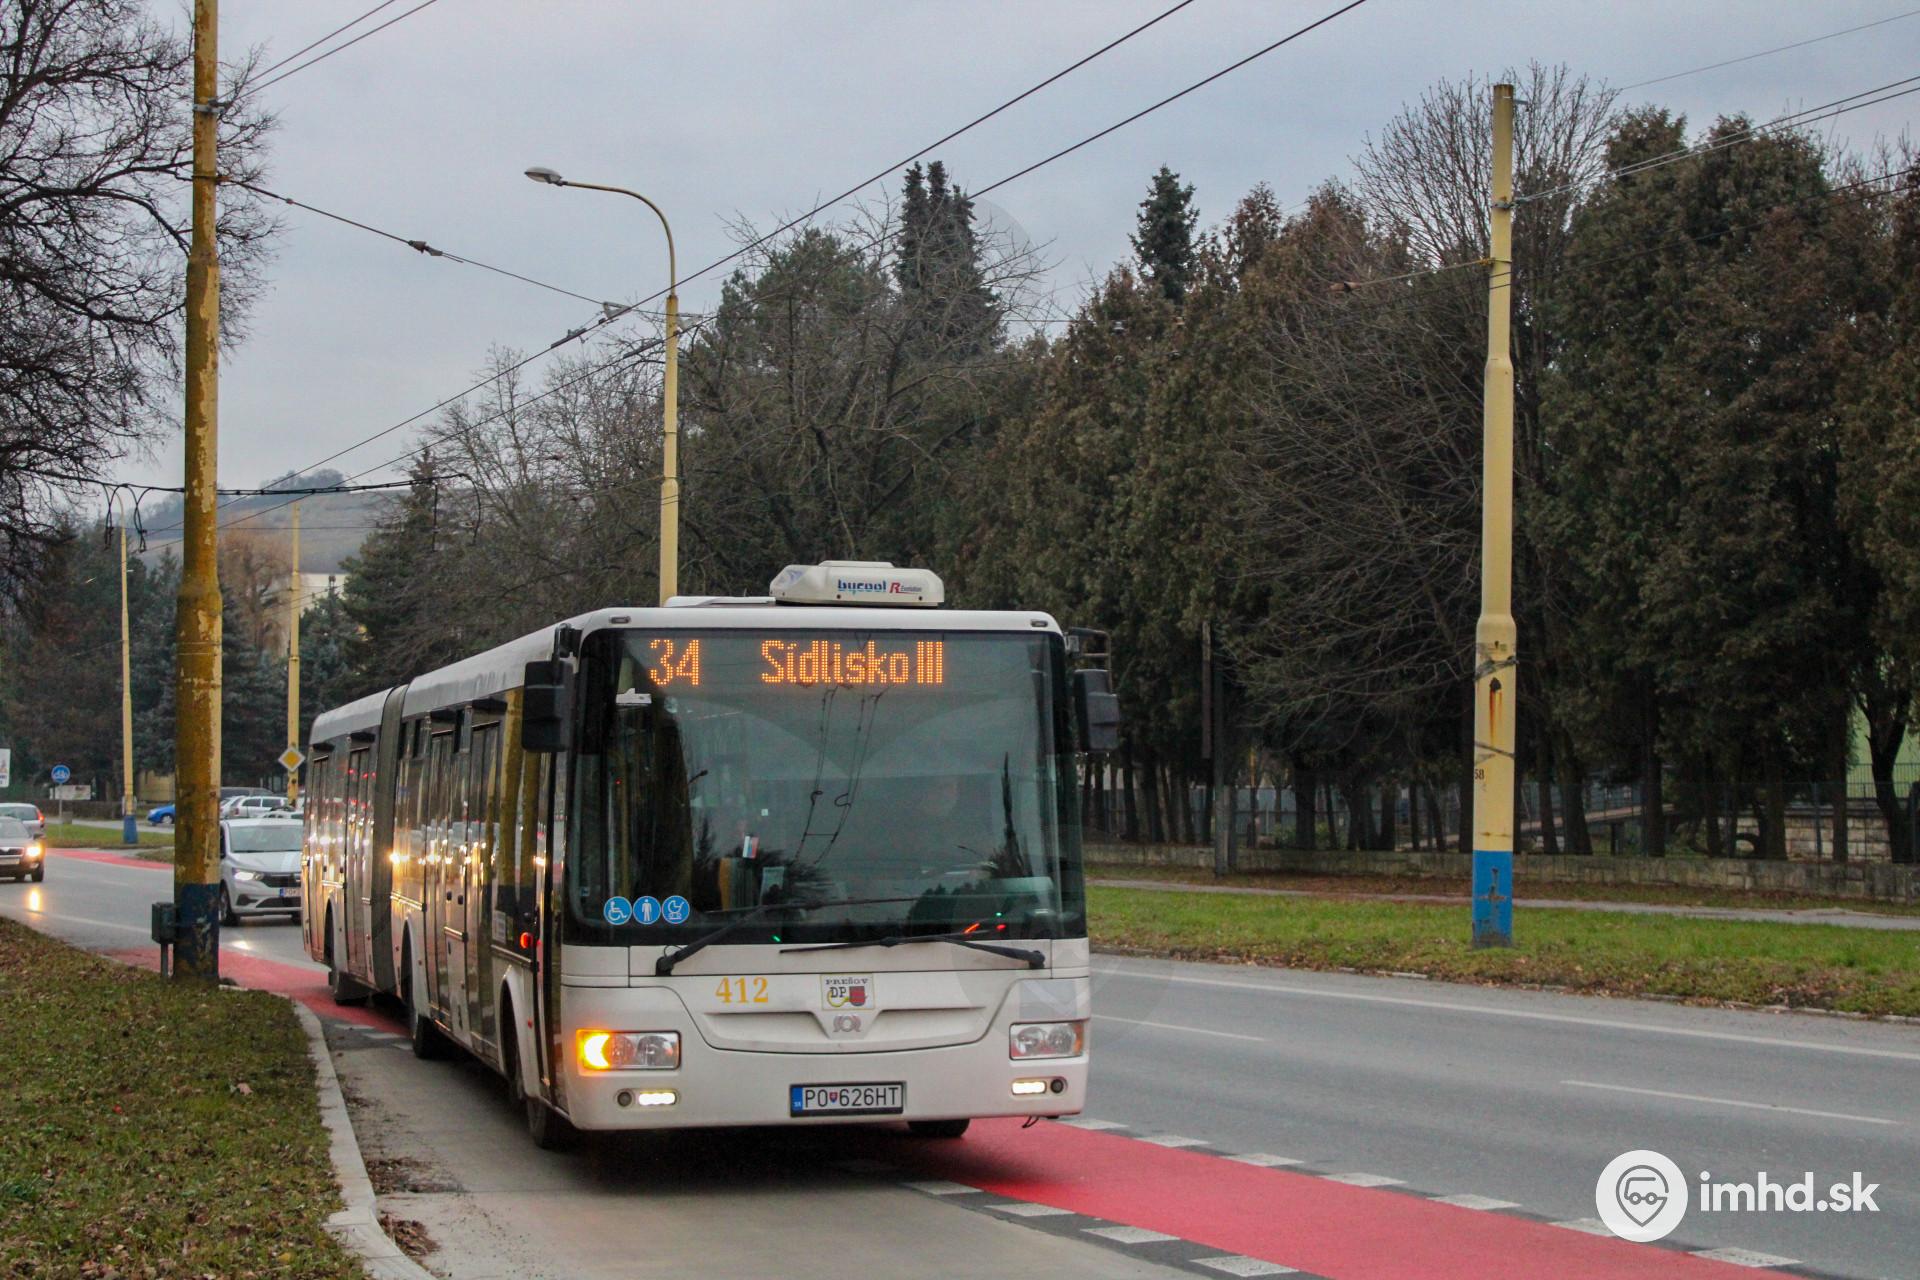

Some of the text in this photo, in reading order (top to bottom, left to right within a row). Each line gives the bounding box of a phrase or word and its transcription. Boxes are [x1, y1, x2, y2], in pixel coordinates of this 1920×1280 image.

[650, 639, 700, 685] 34
[761, 640, 909, 684] Sídlisko
[715, 976, 769, 1003] 412
[830, 986, 847, 998] DP
